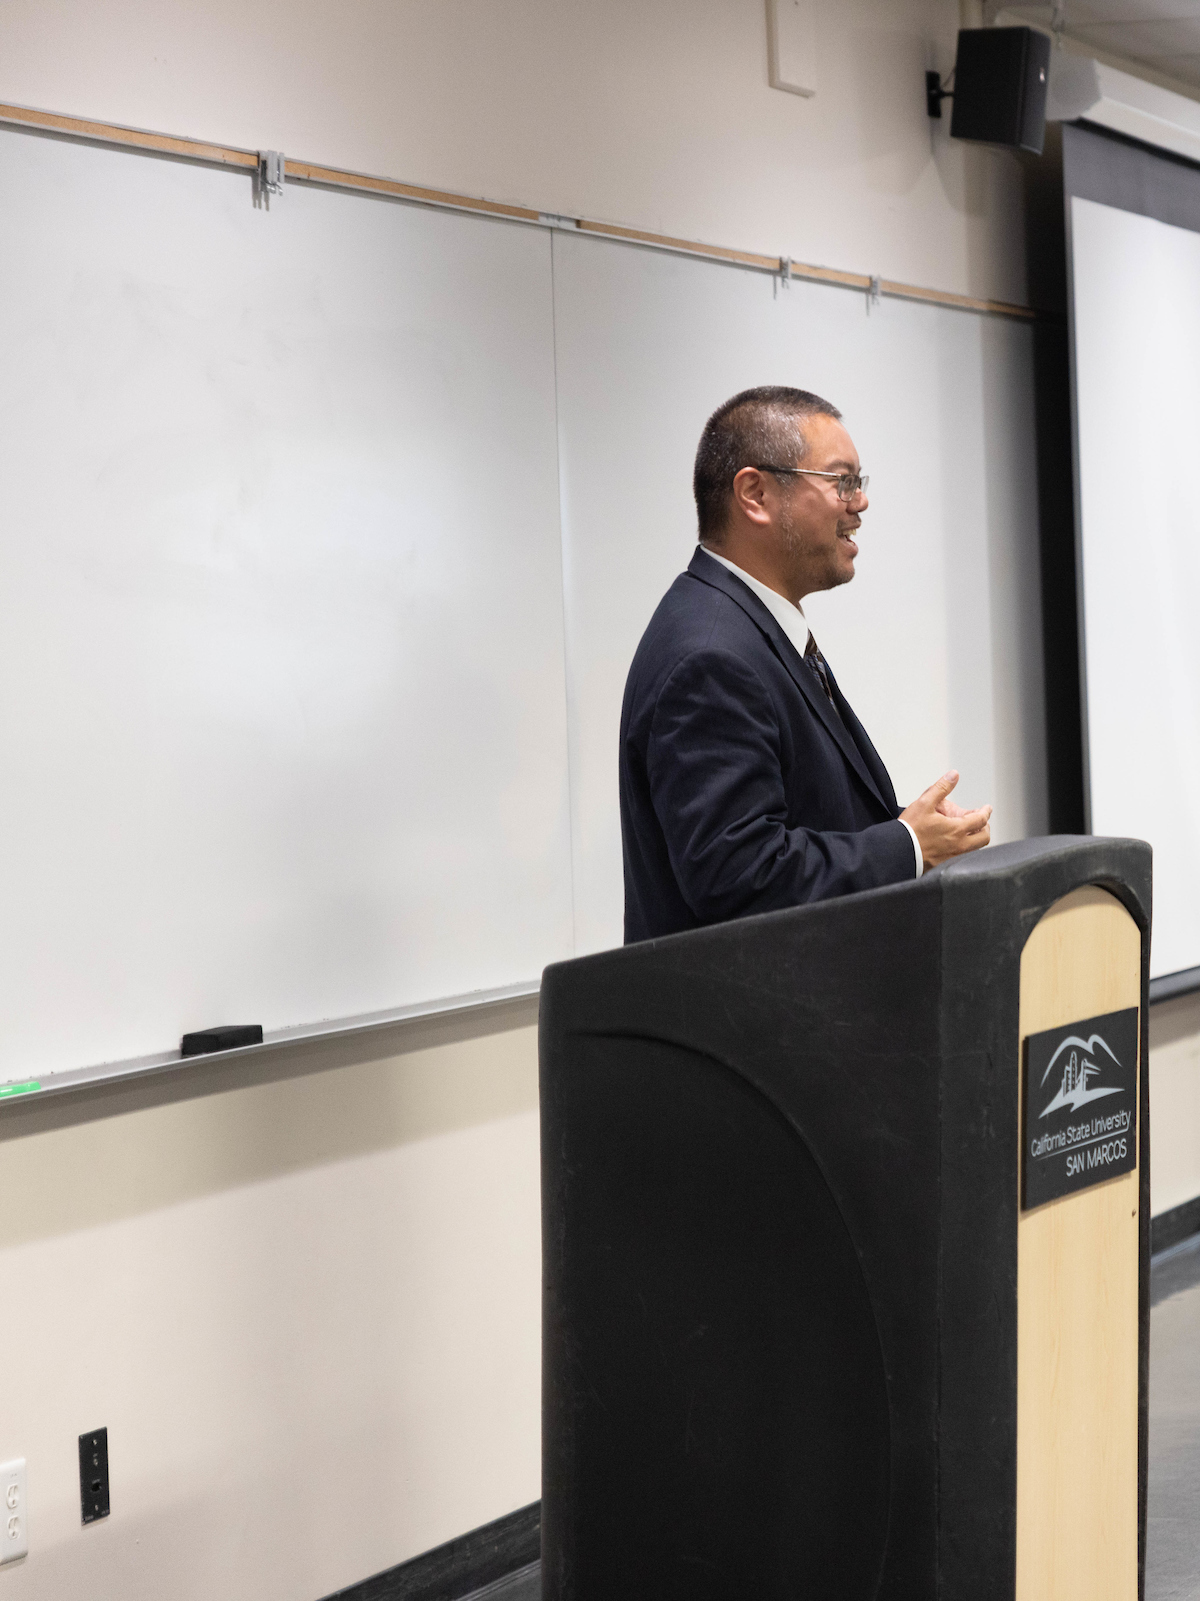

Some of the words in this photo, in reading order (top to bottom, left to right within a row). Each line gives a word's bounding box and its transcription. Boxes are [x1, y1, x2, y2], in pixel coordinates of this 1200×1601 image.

[1030, 1130, 1067, 1157] California
[1066, 1122, 1091, 1145] State
[1091, 1109, 1132, 1136] University
[1066, 1151, 1085, 1177] SAN
[1086, 1138, 1127, 1169] MARCOS
